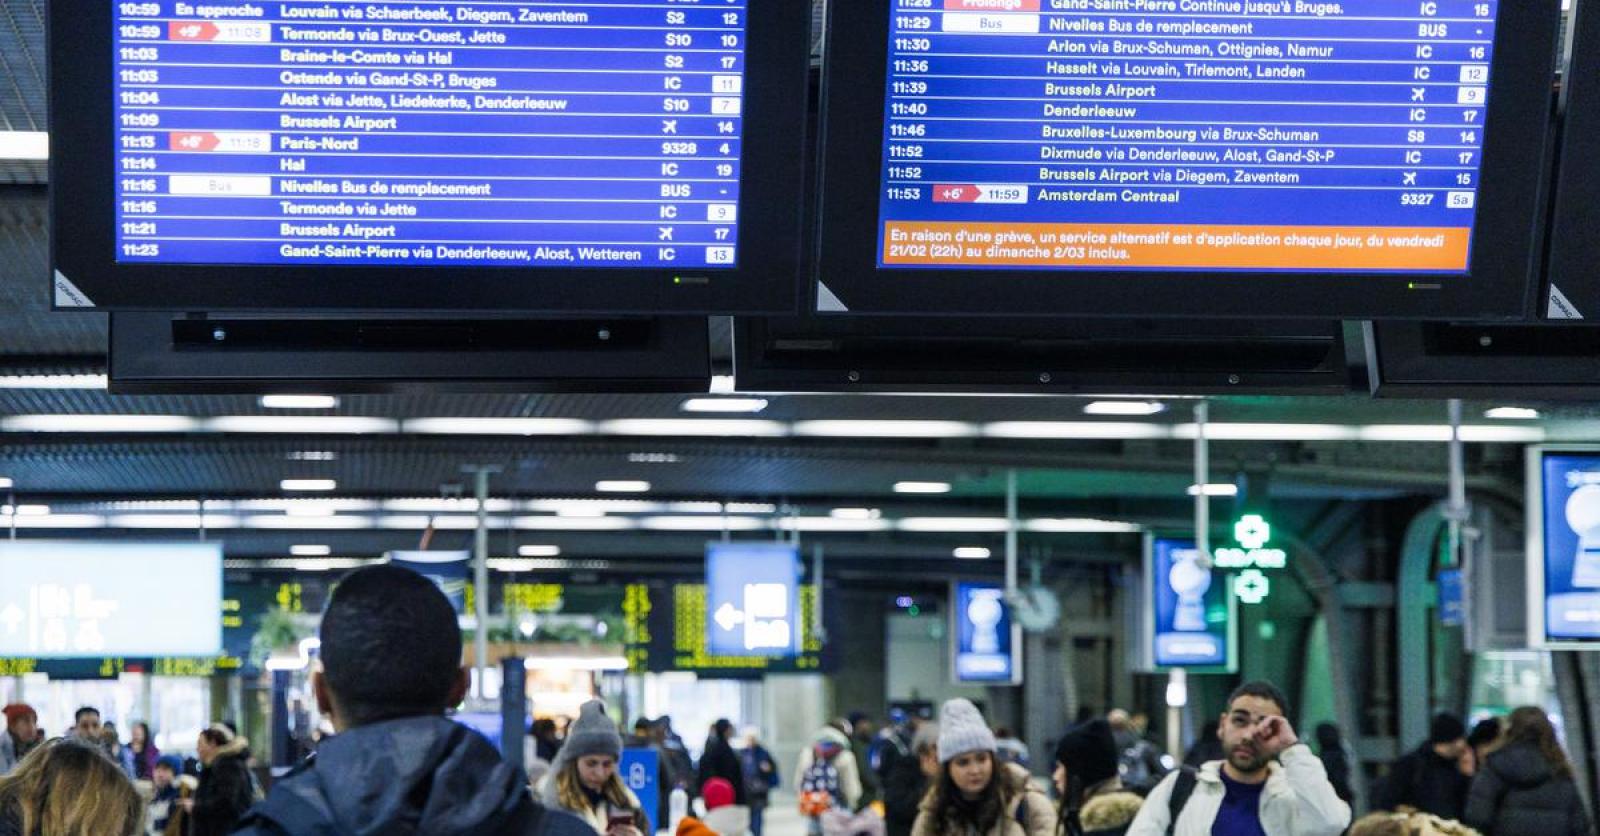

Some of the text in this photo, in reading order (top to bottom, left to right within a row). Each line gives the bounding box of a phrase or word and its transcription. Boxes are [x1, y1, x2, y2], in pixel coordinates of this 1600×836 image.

[176, 3, 194, 15] En
[196, 4, 263, 18] approche
[281, 5, 339, 18] Louvain
[342, 6, 363, 19] via
[366, 6, 453, 22] Schaerbeek,
[457, 8, 515, 24] Diegem,
[518, 8, 588, 22] Zaventem
[666, 11, 684, 24] S2
[723, 13, 738, 24] 12
[1180, 0, 1241, 12] Continue
[1296, 0, 1343, 16] Bruges.
[1420, 2, 1436, 16] IC
[896, 17, 1447, 37] 11:29 Bus Nivelles Bus de remplacement BUS
[280, 27, 355, 41] Termonde
[358, 28, 379, 41] via
[382, 28, 466, 44] Brux-Ouest,
[469, 30, 506, 44] Jette
[666, 33, 691, 46] S10
[721, 35, 737, 47] 10
[895, 38, 1484, 59] 11:30 Arlon via Brux-Schuman, Ottignies, Namur IC 16
[281, 49, 401, 64] Braine-le-Comte
[404, 52, 425, 64] via
[428, 52, 452, 64] Hal
[665, 55, 683, 68] S2
[721, 56, 736, 68] 17
[894, 60, 1480, 80] 11:36 Hasselt via Louvain, Tirlemont, Landen IC 12
[280, 71, 343, 85] Ostende
[346, 72, 367, 85] via
[369, 72, 445, 88] Gand-St-P,
[449, 74, 496, 90] Bruges
[664, 76, 681, 90] IC
[893, 82, 1156, 99] 11:39 Brussels Airport
[280, 93, 319, 106] Alost
[322, 94, 343, 106] via
[346, 94, 387, 108] Jette,
[391, 94, 471, 110] Liedekerke,
[475, 96, 567, 109] Denderleeuw
[664, 98, 689, 111] S10
[892, 103, 1477, 122] 11:40 Denderleeuw IC 17
[281, 114, 341, 128] Brussels
[344, 116, 396, 131] Airport
[718, 122, 734, 133] 14
[891, 124, 1475, 143] 11:46 Bruxelles-Luxembourg via Brux-Schuman 14
[281, 136, 730, 154] Paris-Nord 9328 4
[889, 146, 1472, 164] 11:52 Dixmude via Denderleeuw, Alost, Gand-St-P IC 17
[281, 158, 305, 171] Hal
[662, 163, 678, 176] IC
[716, 164, 732, 176] 19
[889, 167, 1470, 184] 11:52 Brussels Airport via Diegem, Zaventem 15
[281, 180, 690, 197] Nivelles Bus de remplacement BUS
[887, 188, 1468, 205] 11:53 +6' 11:59 Amsterdam Centraal 9327 5a
[280, 201, 676, 218] Termonde via Jette IC
[281, 223, 340, 236] Brussels
[343, 224, 395, 239] Airport
[714, 228, 729, 240] 17
[891, 229, 1444, 247] En raison d'une grève, un service alternatif est d'application chaque jour, du vendredi
[280, 244, 409, 258] Gand-Saint-Pierre
[413, 246, 433, 258] via
[437, 246, 530, 261] Denderleeuw,
[534, 247, 574, 261] Alost,
[578, 248, 641, 260] Wetteren
[659, 248, 675, 260] IC
[714, 250, 727, 260] 13
[890, 244, 1129, 259] 21/02 (22h) au dimanche 2/03 inclus.
